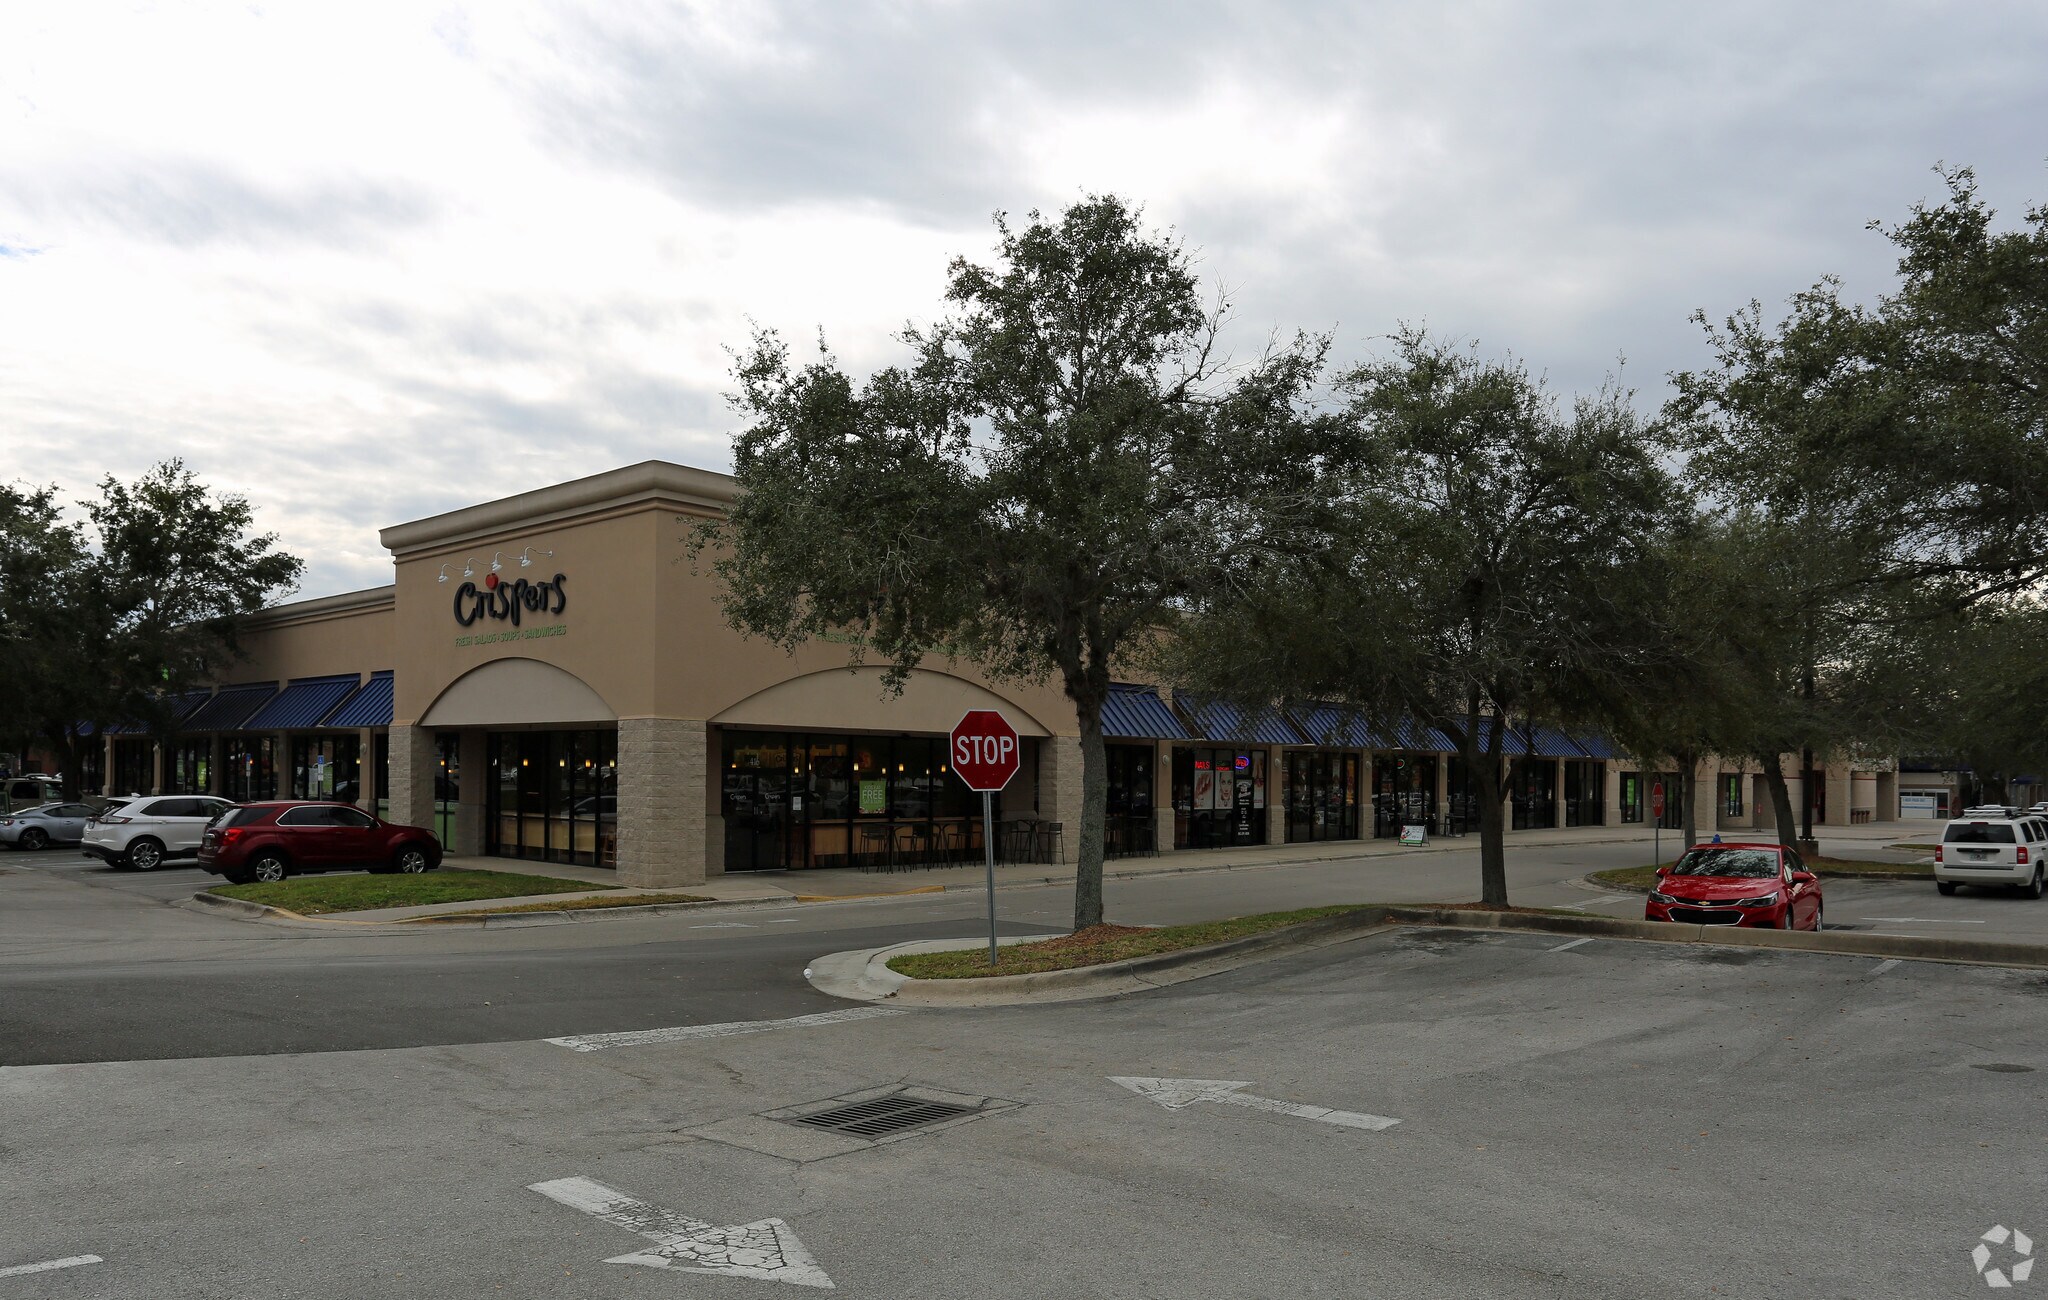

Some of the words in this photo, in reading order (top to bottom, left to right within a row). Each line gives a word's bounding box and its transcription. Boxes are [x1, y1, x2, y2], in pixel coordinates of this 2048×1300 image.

[454, 573, 567, 627] Crispers
[455, 635, 473, 647] FRESH
[474, 633, 497, 645] SALADS
[500, 630, 520, 642] SOUPS
[524, 625, 567, 639] SANDWICHES
[956, 735, 1014, 765] STOP
[1195, 761, 1210, 769] NAILS
[862, 790, 883, 800] FREE
[1653, 794, 1664, 807] STOP
